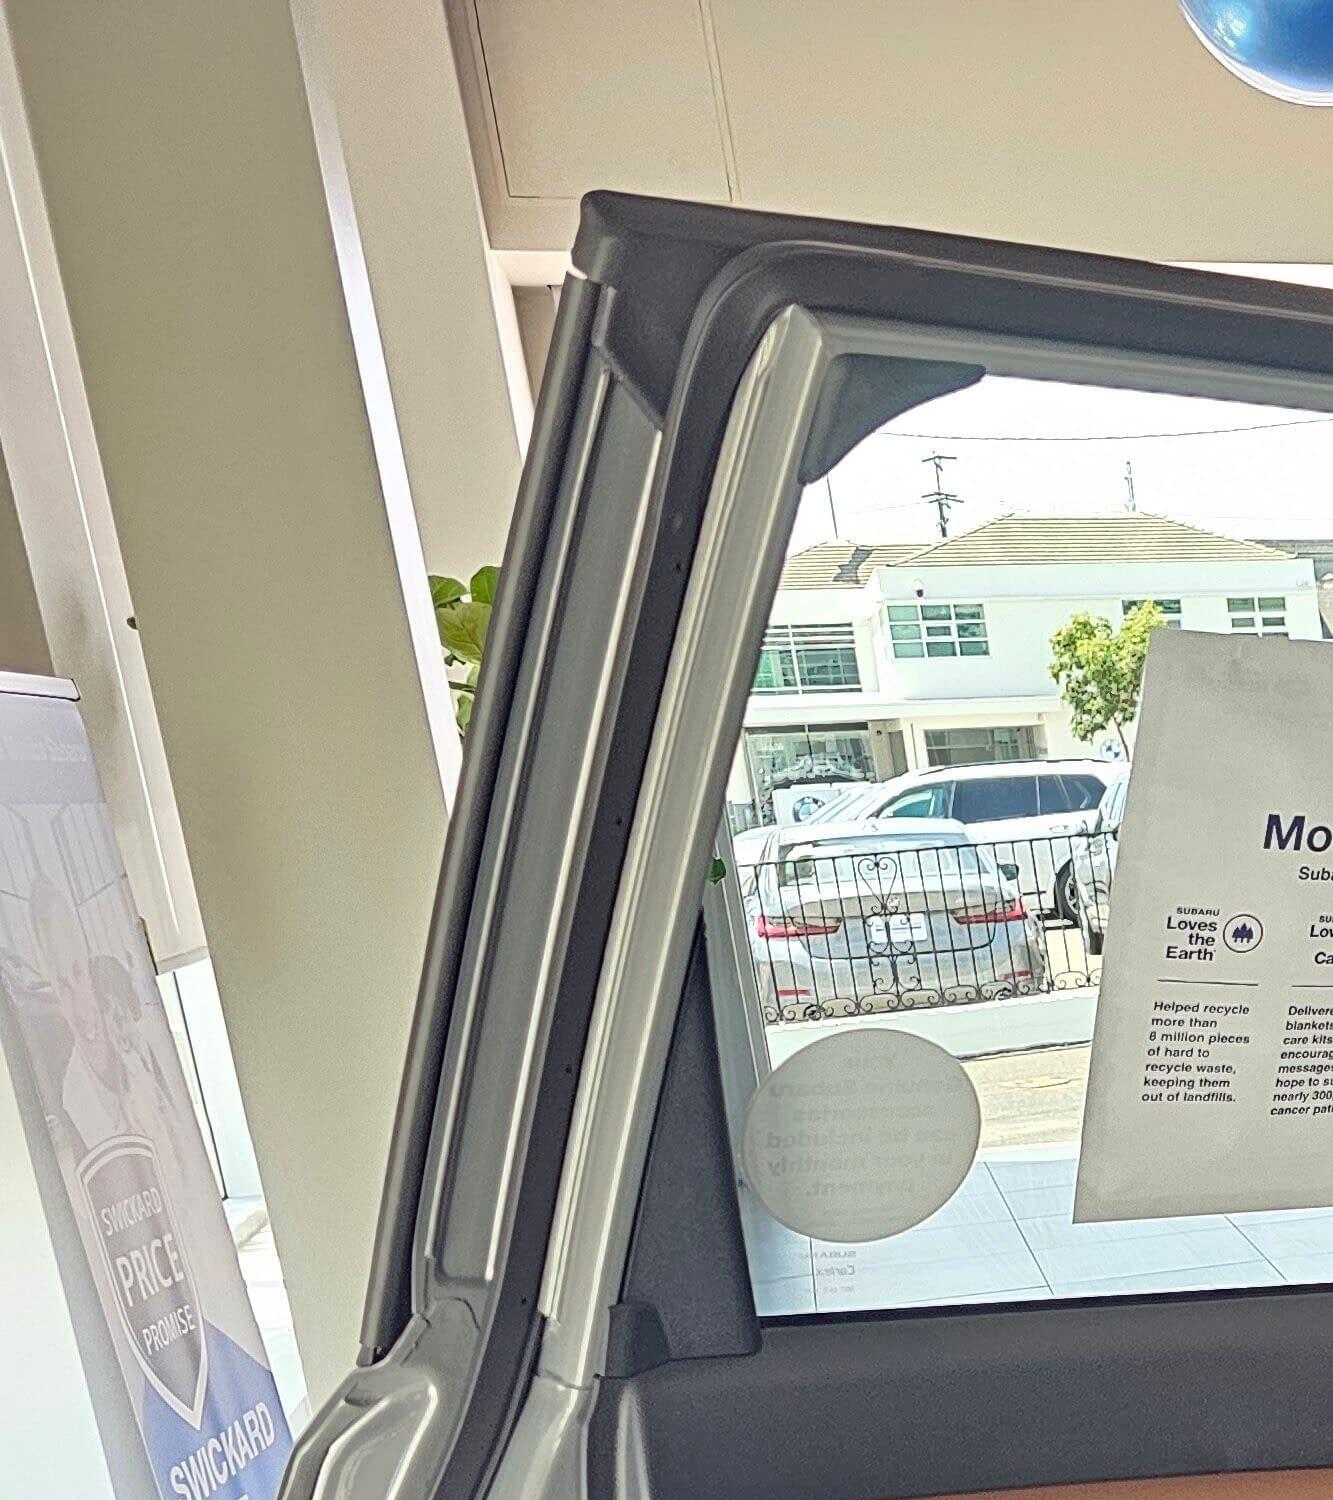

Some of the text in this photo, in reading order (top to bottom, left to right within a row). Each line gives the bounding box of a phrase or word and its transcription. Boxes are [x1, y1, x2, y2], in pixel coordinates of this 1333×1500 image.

[1176, 906, 1221, 917] SUBARU
[1166, 915, 1218, 933] Loves
[1187, 931, 1216, 947] the
[1165, 945, 1217, 962] Earth
[1153, 1000, 1250, 1017] Helped recycle
[1151, 1017, 1218, 1029] more than
[1160, 1031, 1205, 1043] million
[1207, 1031, 1250, 1046] pieces
[1282, 1036, 1309, 1046] care
[1147, 1045, 1210, 1059] of hard to
[1145, 1061, 1237, 1075] recycle waste,
[1143, 1075, 1231, 1091] keeping them
[1275, 1077, 1306, 1090] hope
[1308, 1077, 1320, 1087] to
[1141, 1091, 1236, 1103] out of landfills.
[1272, 1091, 1310, 1104] nearly
[1270, 1106, 1311, 1116] cancer
[101, 1187, 162, 1236] SWICKARD
[116, 1233, 184, 1307] PRICE
[142, 1304, 197, 1354] PROMISE
